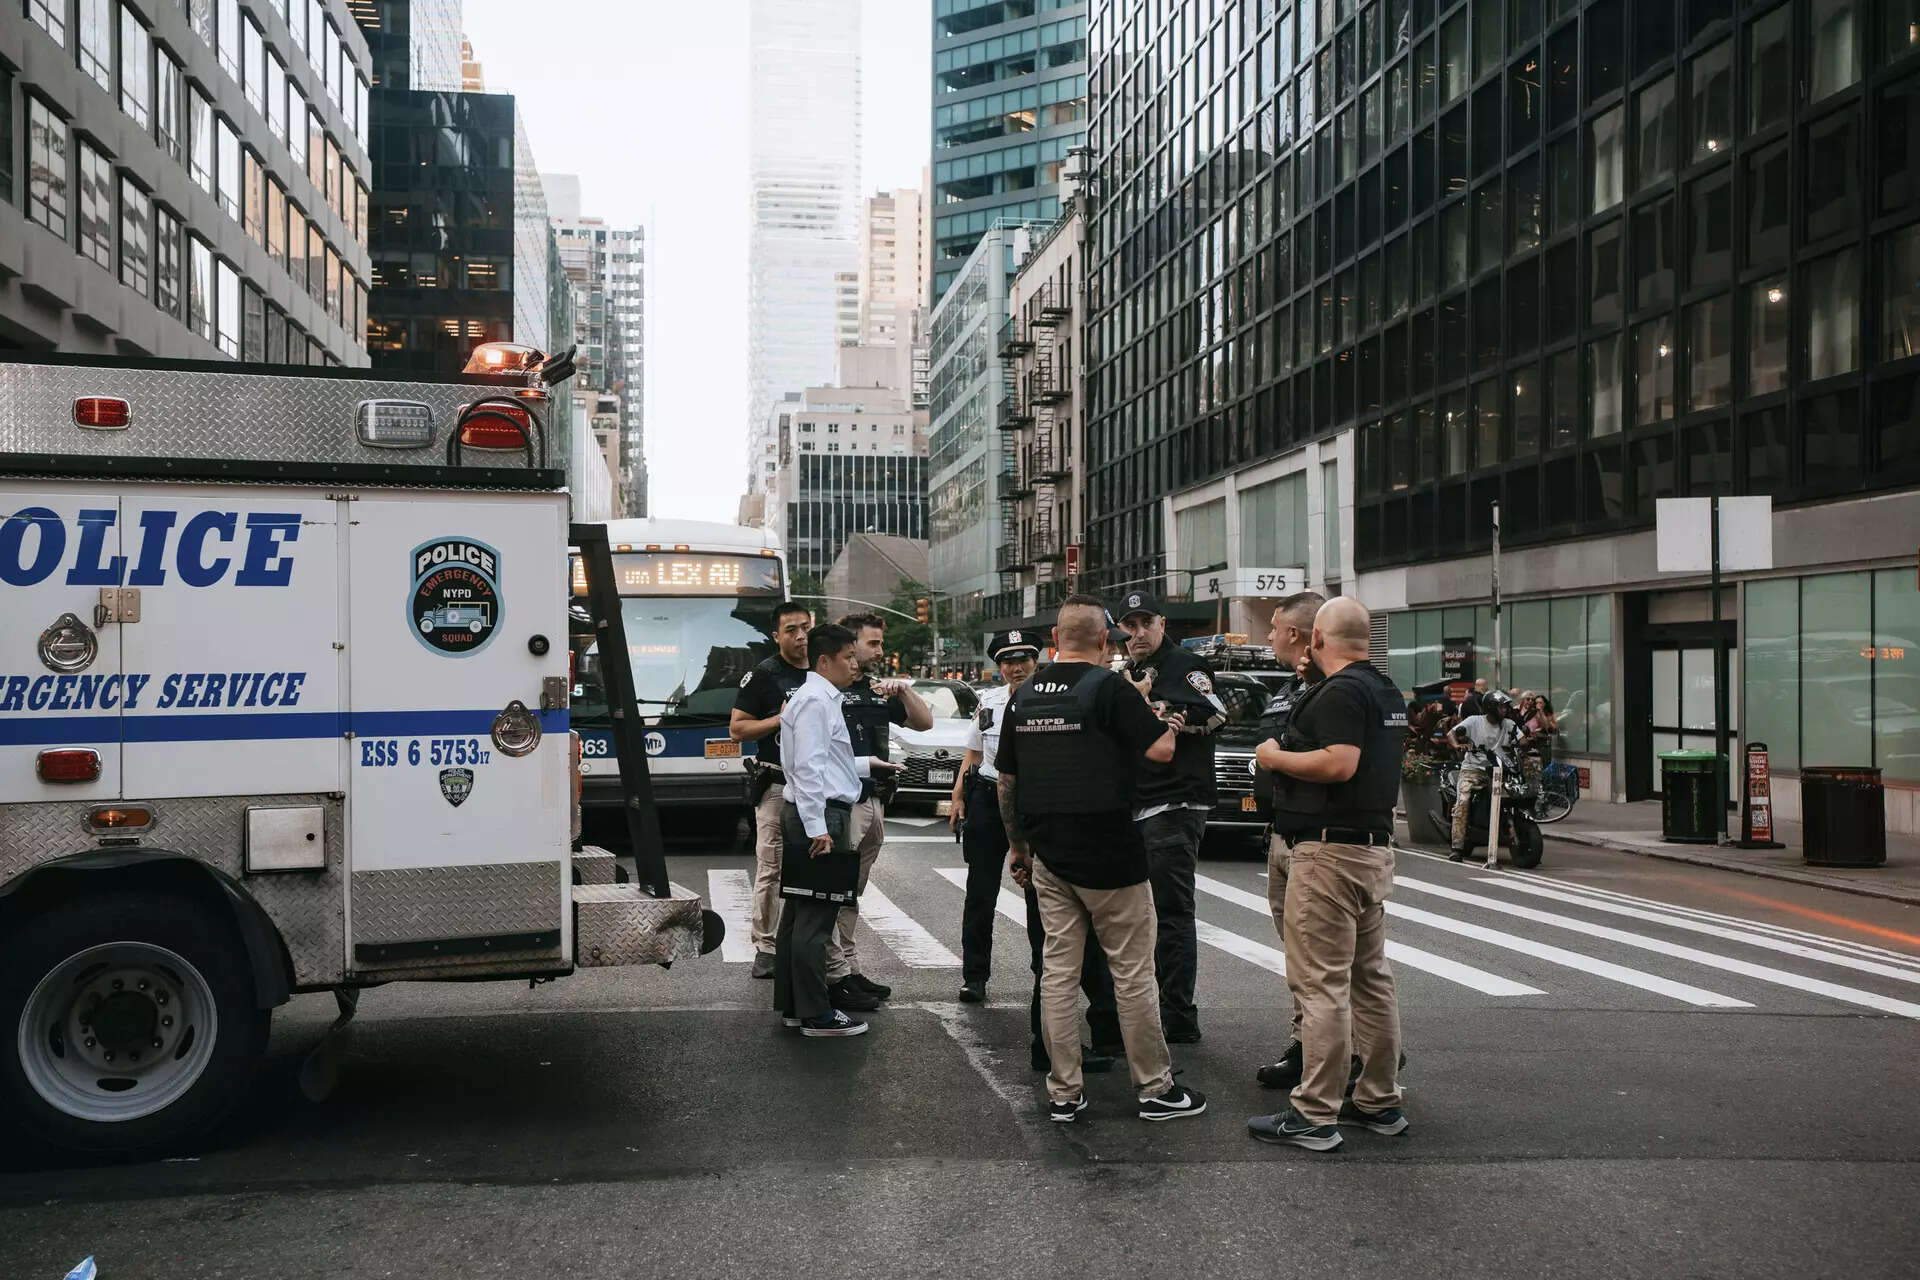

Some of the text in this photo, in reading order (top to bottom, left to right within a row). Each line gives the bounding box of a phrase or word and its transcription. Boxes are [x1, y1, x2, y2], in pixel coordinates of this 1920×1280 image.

[418, 544, 494, 575] POLICE
[420, 569, 492, 597] EMERGENCY
[658, 561, 701, 585] LEX
[1256, 574, 1286, 590] 575
[443, 589, 472, 598] NYPD
[442, 633, 473, 642] SQUAD
[0, 672, 306, 711] RGENCY SERVICE
[360, 740, 399, 767] ESS
[407, 739, 421, 766] 6
[581, 738, 662, 755] 63 MTA
